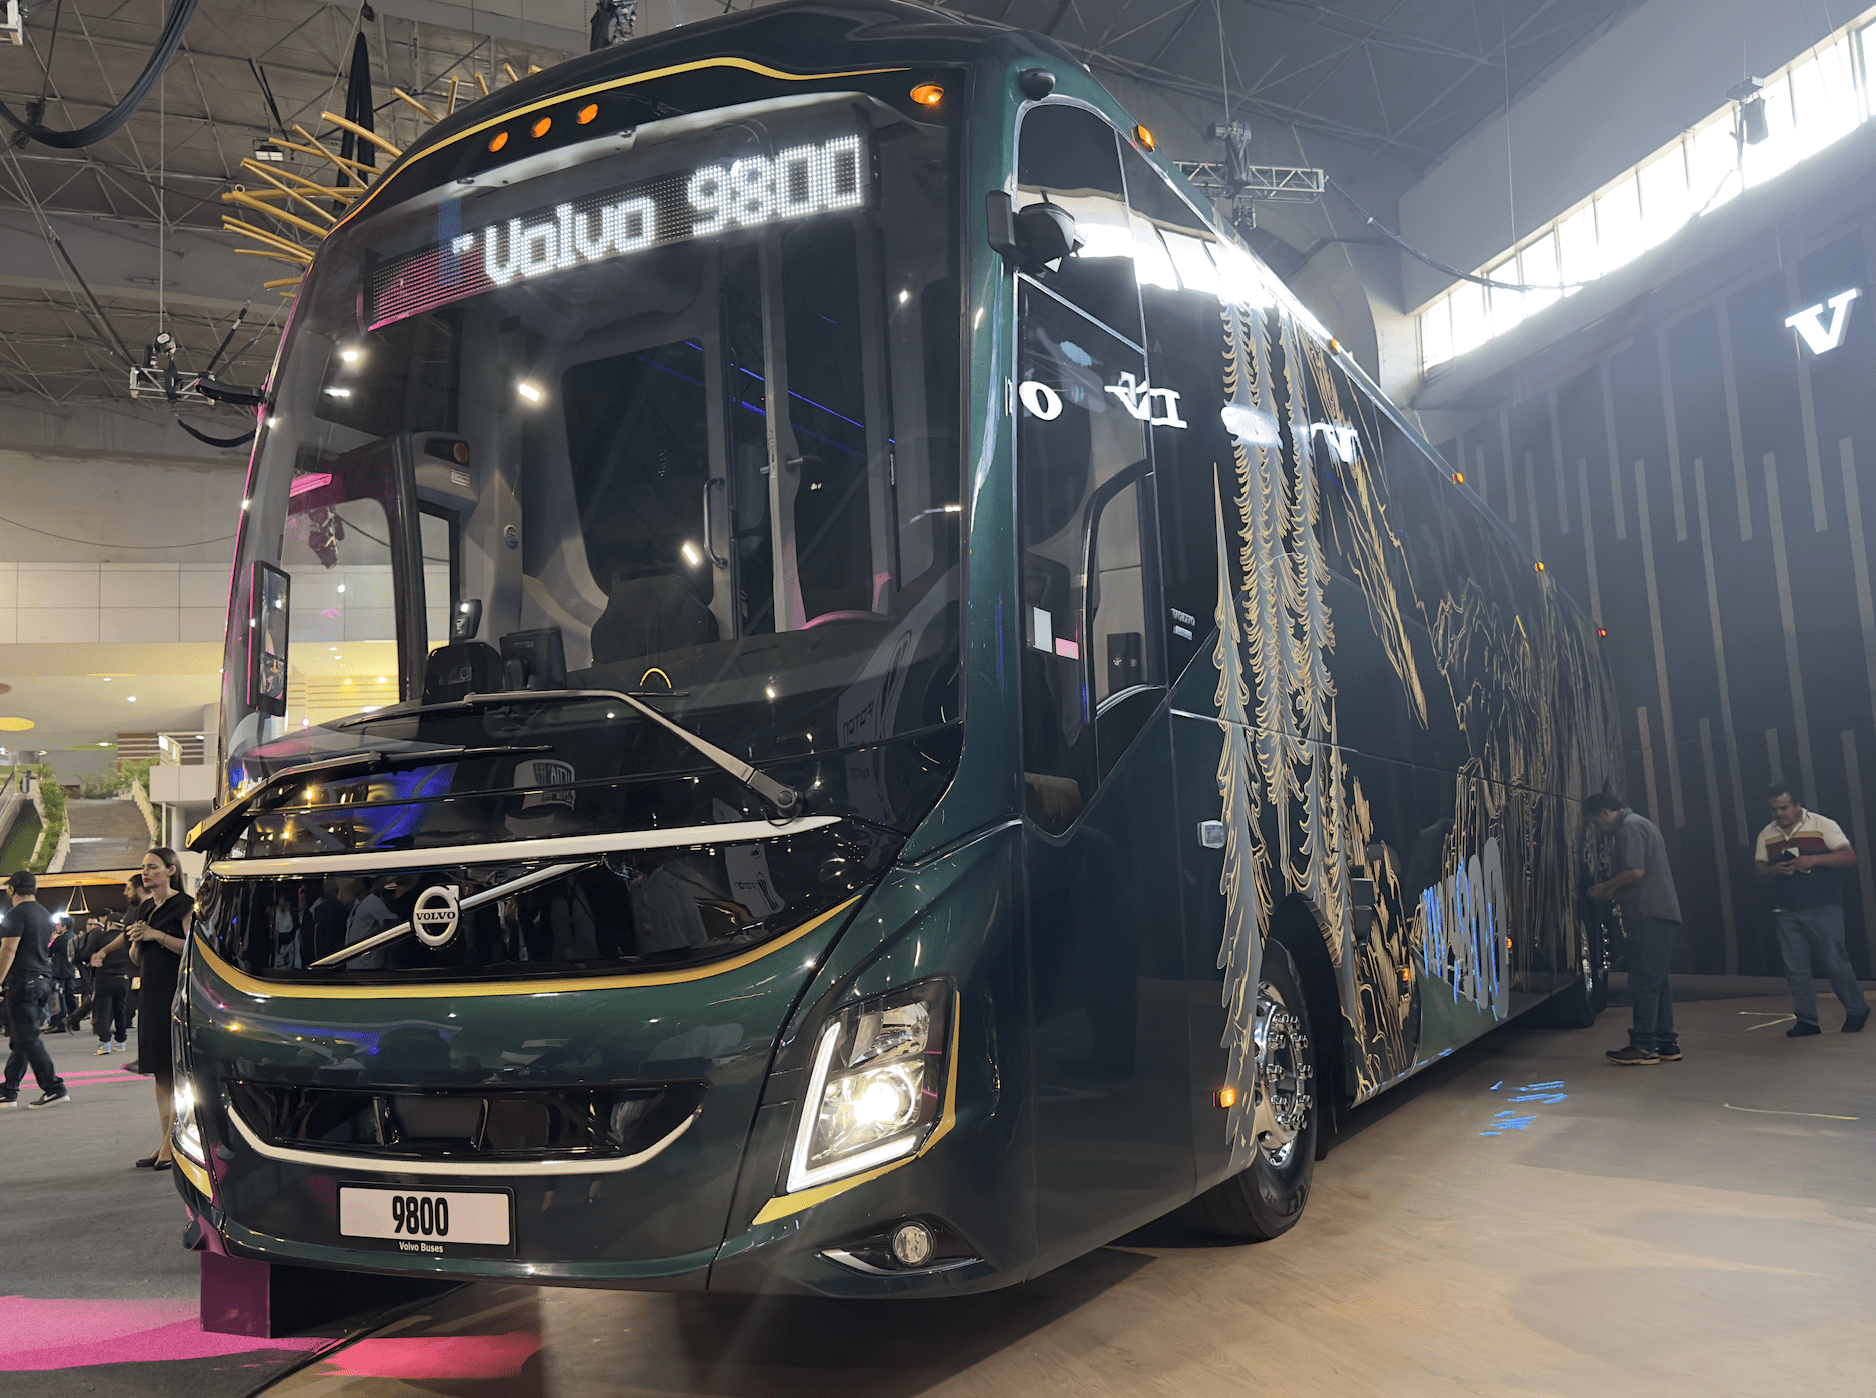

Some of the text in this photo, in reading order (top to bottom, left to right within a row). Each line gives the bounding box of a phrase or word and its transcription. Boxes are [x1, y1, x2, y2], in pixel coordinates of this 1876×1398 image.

[484, 135, 864, 286] Volvo 9800
[416, 911, 456, 921] VOLVO
[392, 1195, 449, 1237] 9800
[399, 1241, 444, 1253] Volvo Buses
